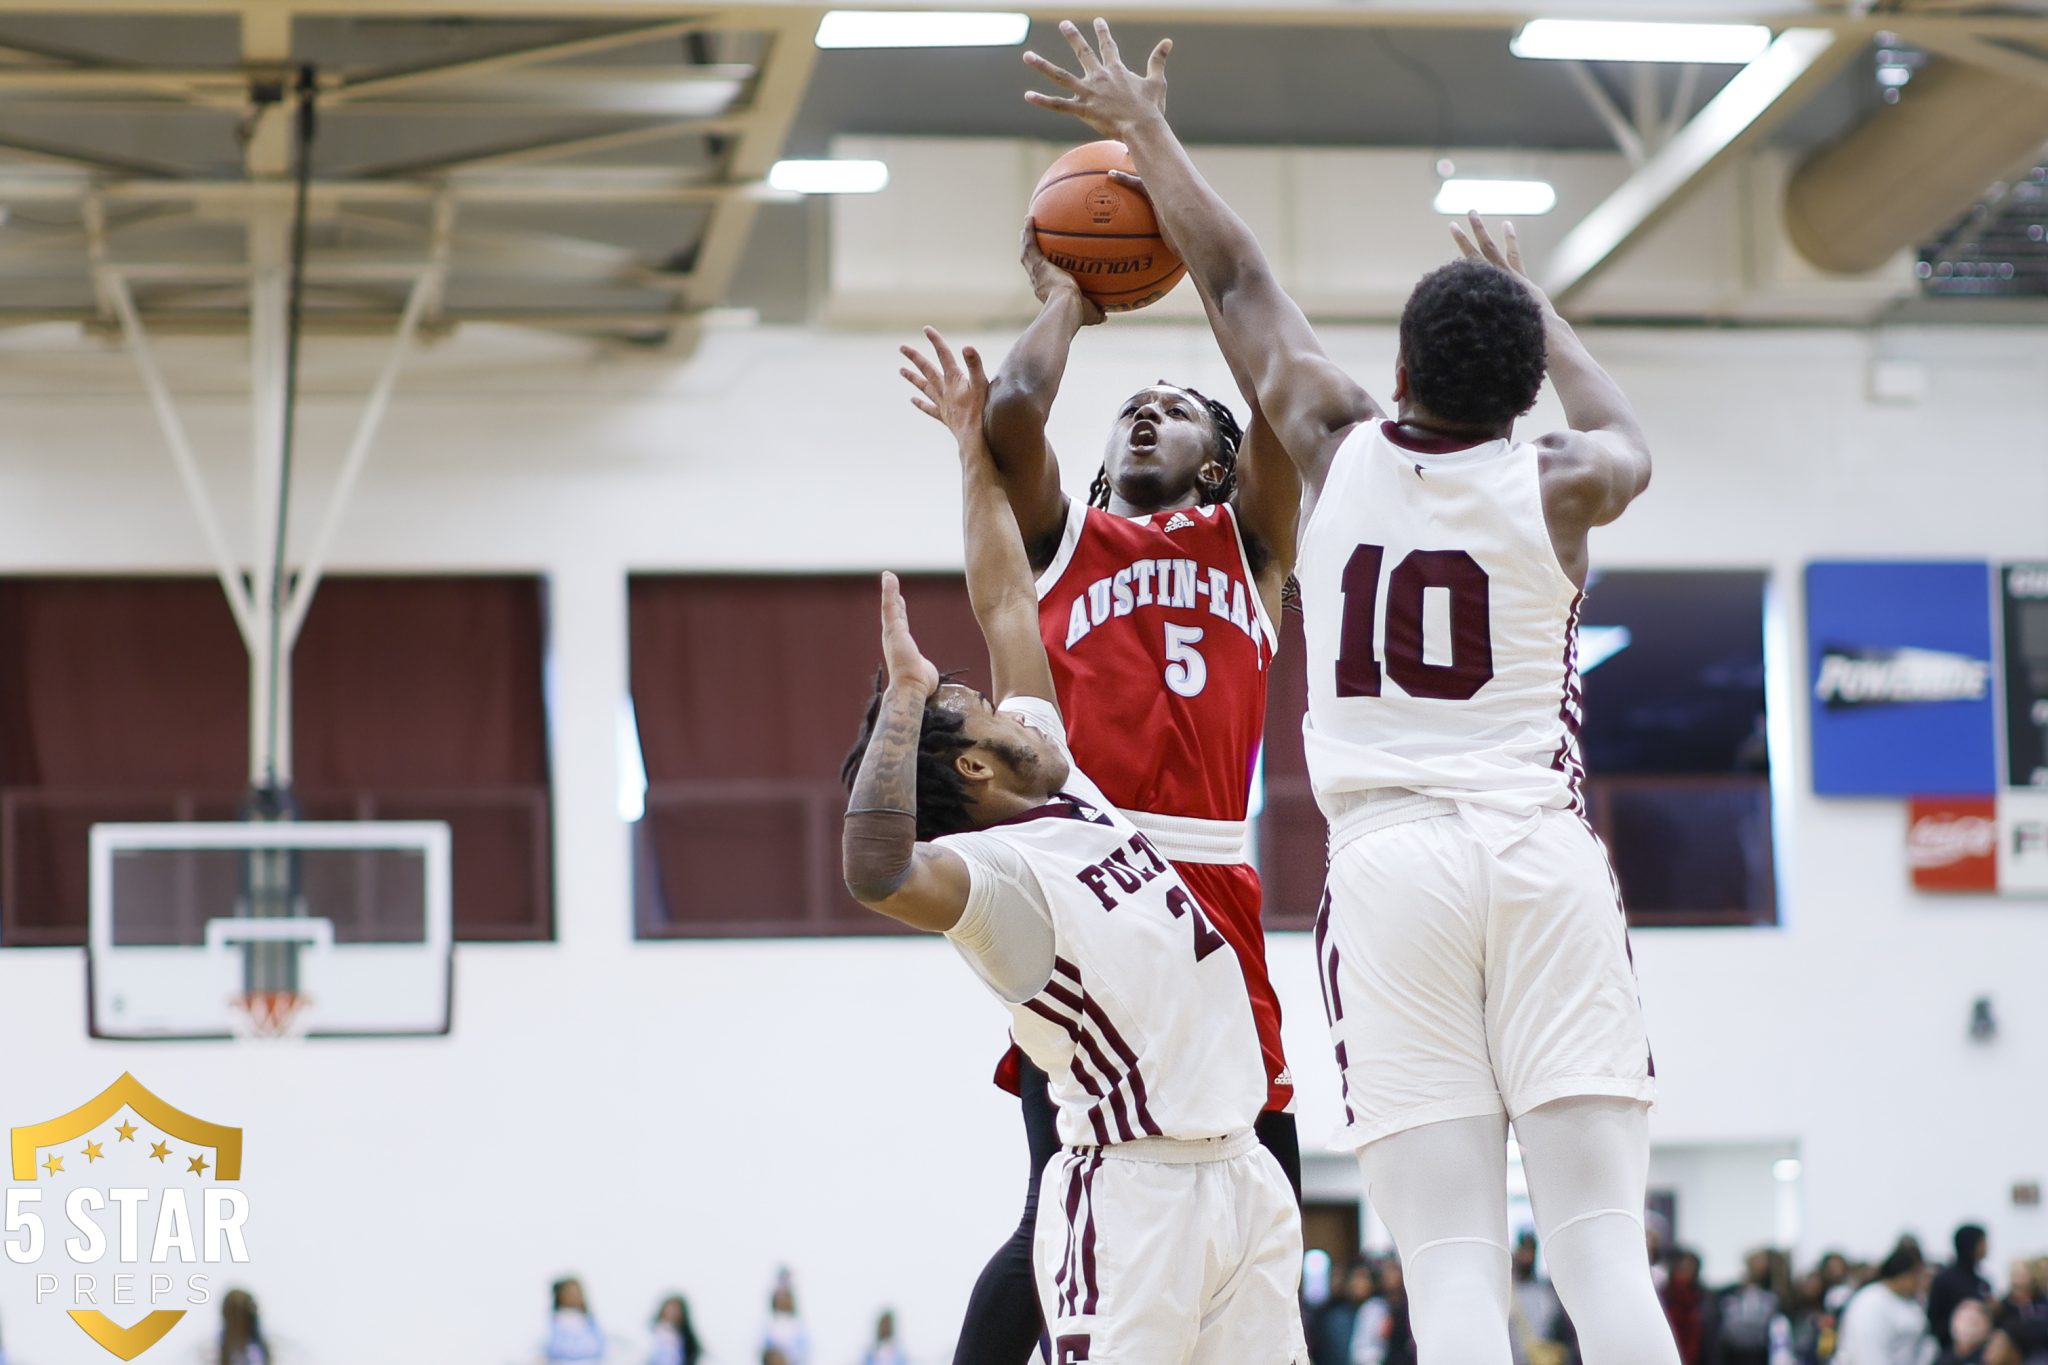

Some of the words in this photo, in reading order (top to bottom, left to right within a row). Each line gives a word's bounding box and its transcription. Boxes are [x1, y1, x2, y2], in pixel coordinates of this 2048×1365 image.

[1164, 520, 1195, 533] adidas
[1065, 558, 1262, 670] AUSTIN-EA
[1335, 543, 1494, 701] 10
[1163, 620, 1208, 698] 5
[1076, 831, 1167, 913] FULT
[1166, 885, 1226, 963] 2
